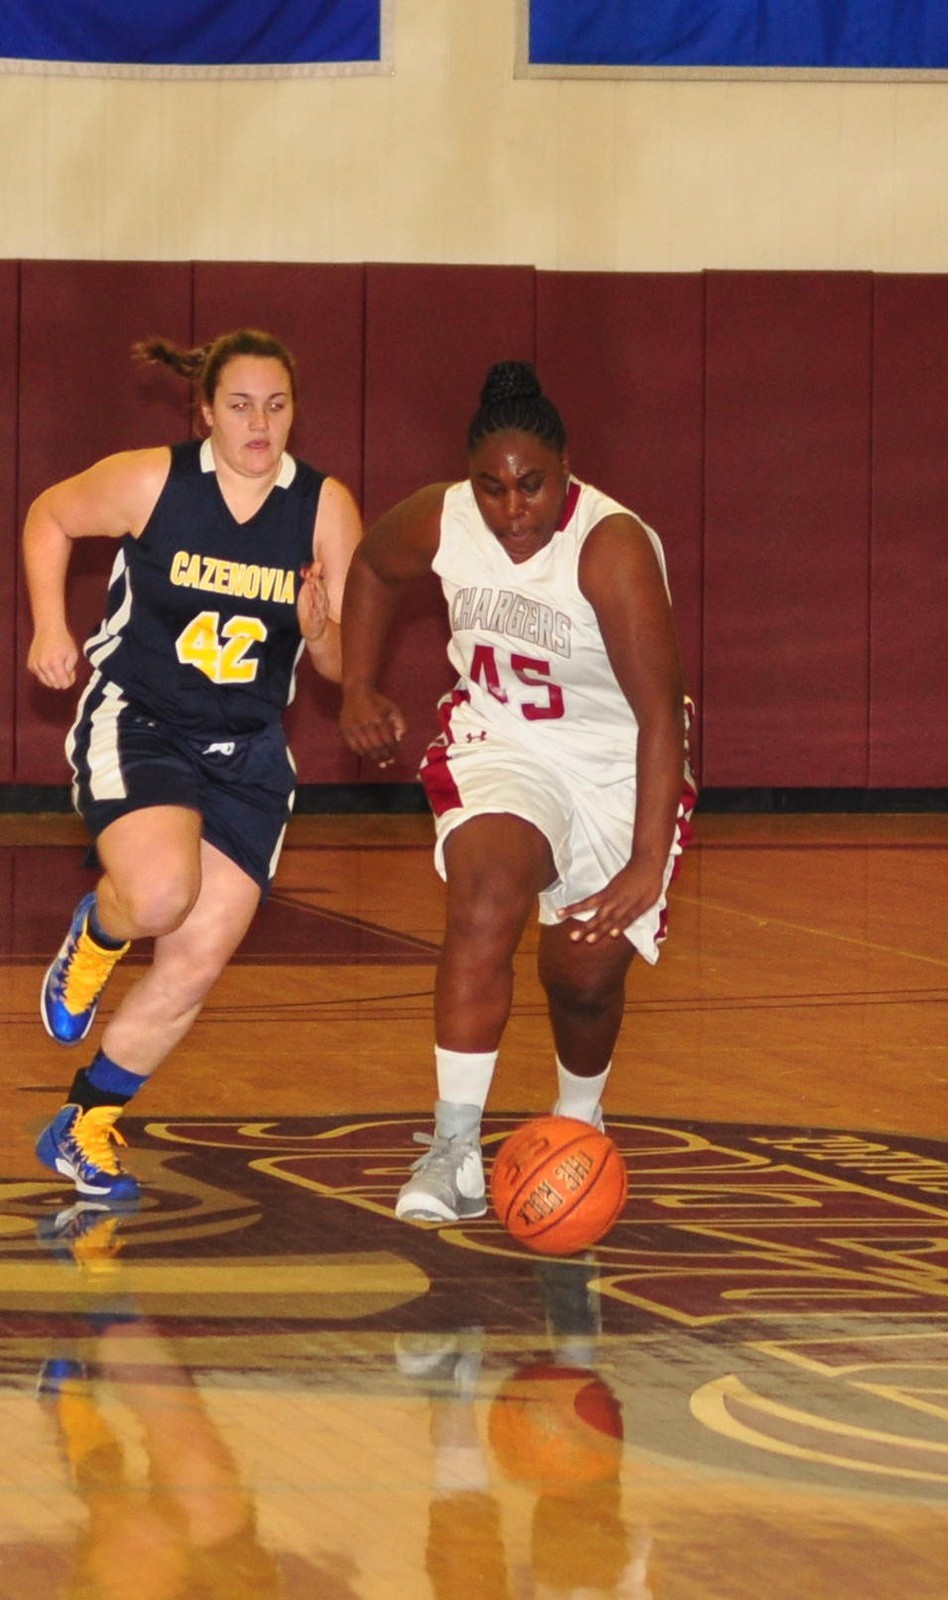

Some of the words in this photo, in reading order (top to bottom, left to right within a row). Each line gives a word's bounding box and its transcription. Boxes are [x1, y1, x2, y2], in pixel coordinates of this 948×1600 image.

[169, 550, 296, 605] CAZENOVIA
[174, 610, 268, 685] 42
[452, 586, 572, 660] CHARGERS
[554, 1149, 595, 1192] THE
[747, 1134, 948, 1194] OLLEGE
[516, 1178, 565, 1227] ROCK
